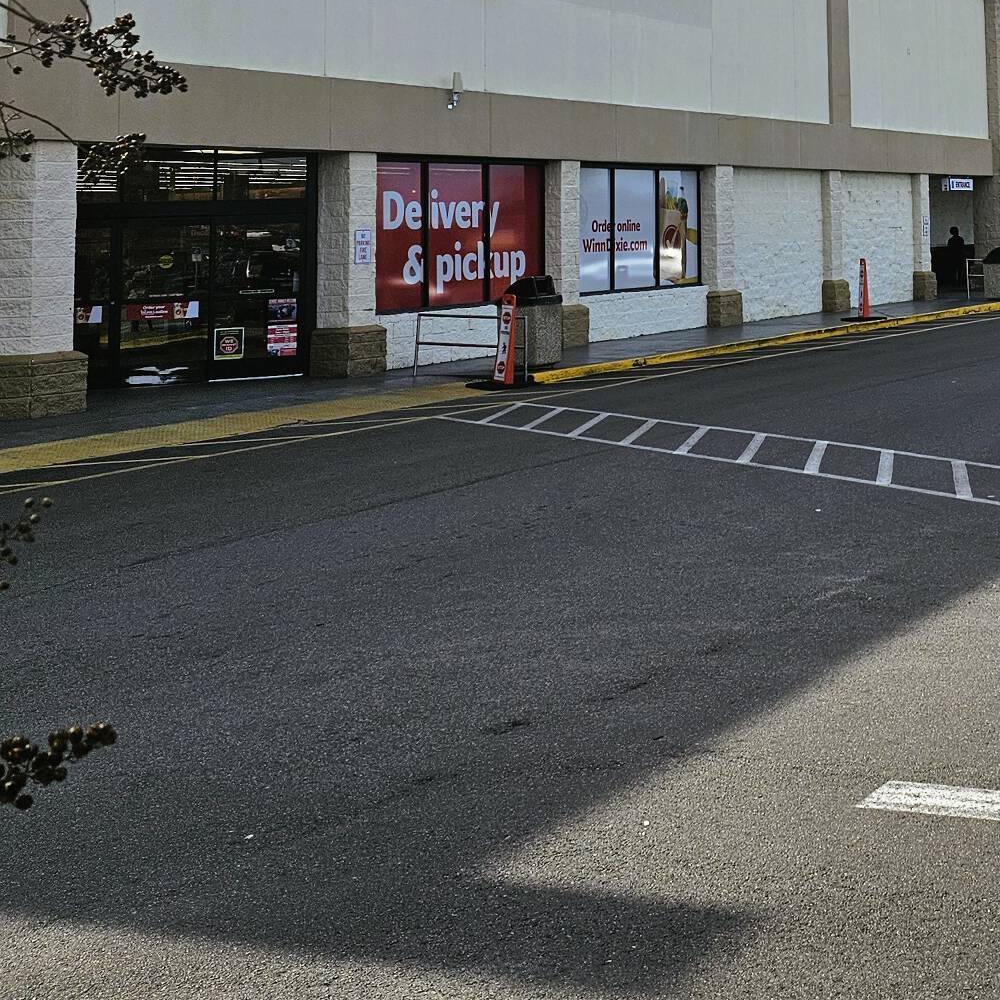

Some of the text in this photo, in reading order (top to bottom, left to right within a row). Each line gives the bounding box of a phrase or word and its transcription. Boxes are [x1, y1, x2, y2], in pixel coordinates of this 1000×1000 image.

[383, 189, 499, 238] Deivery
[591, 219, 641, 233] Orde online
[582, 237, 648, 253] WinnDxie.com
[402, 240, 526, 294] & pickup
